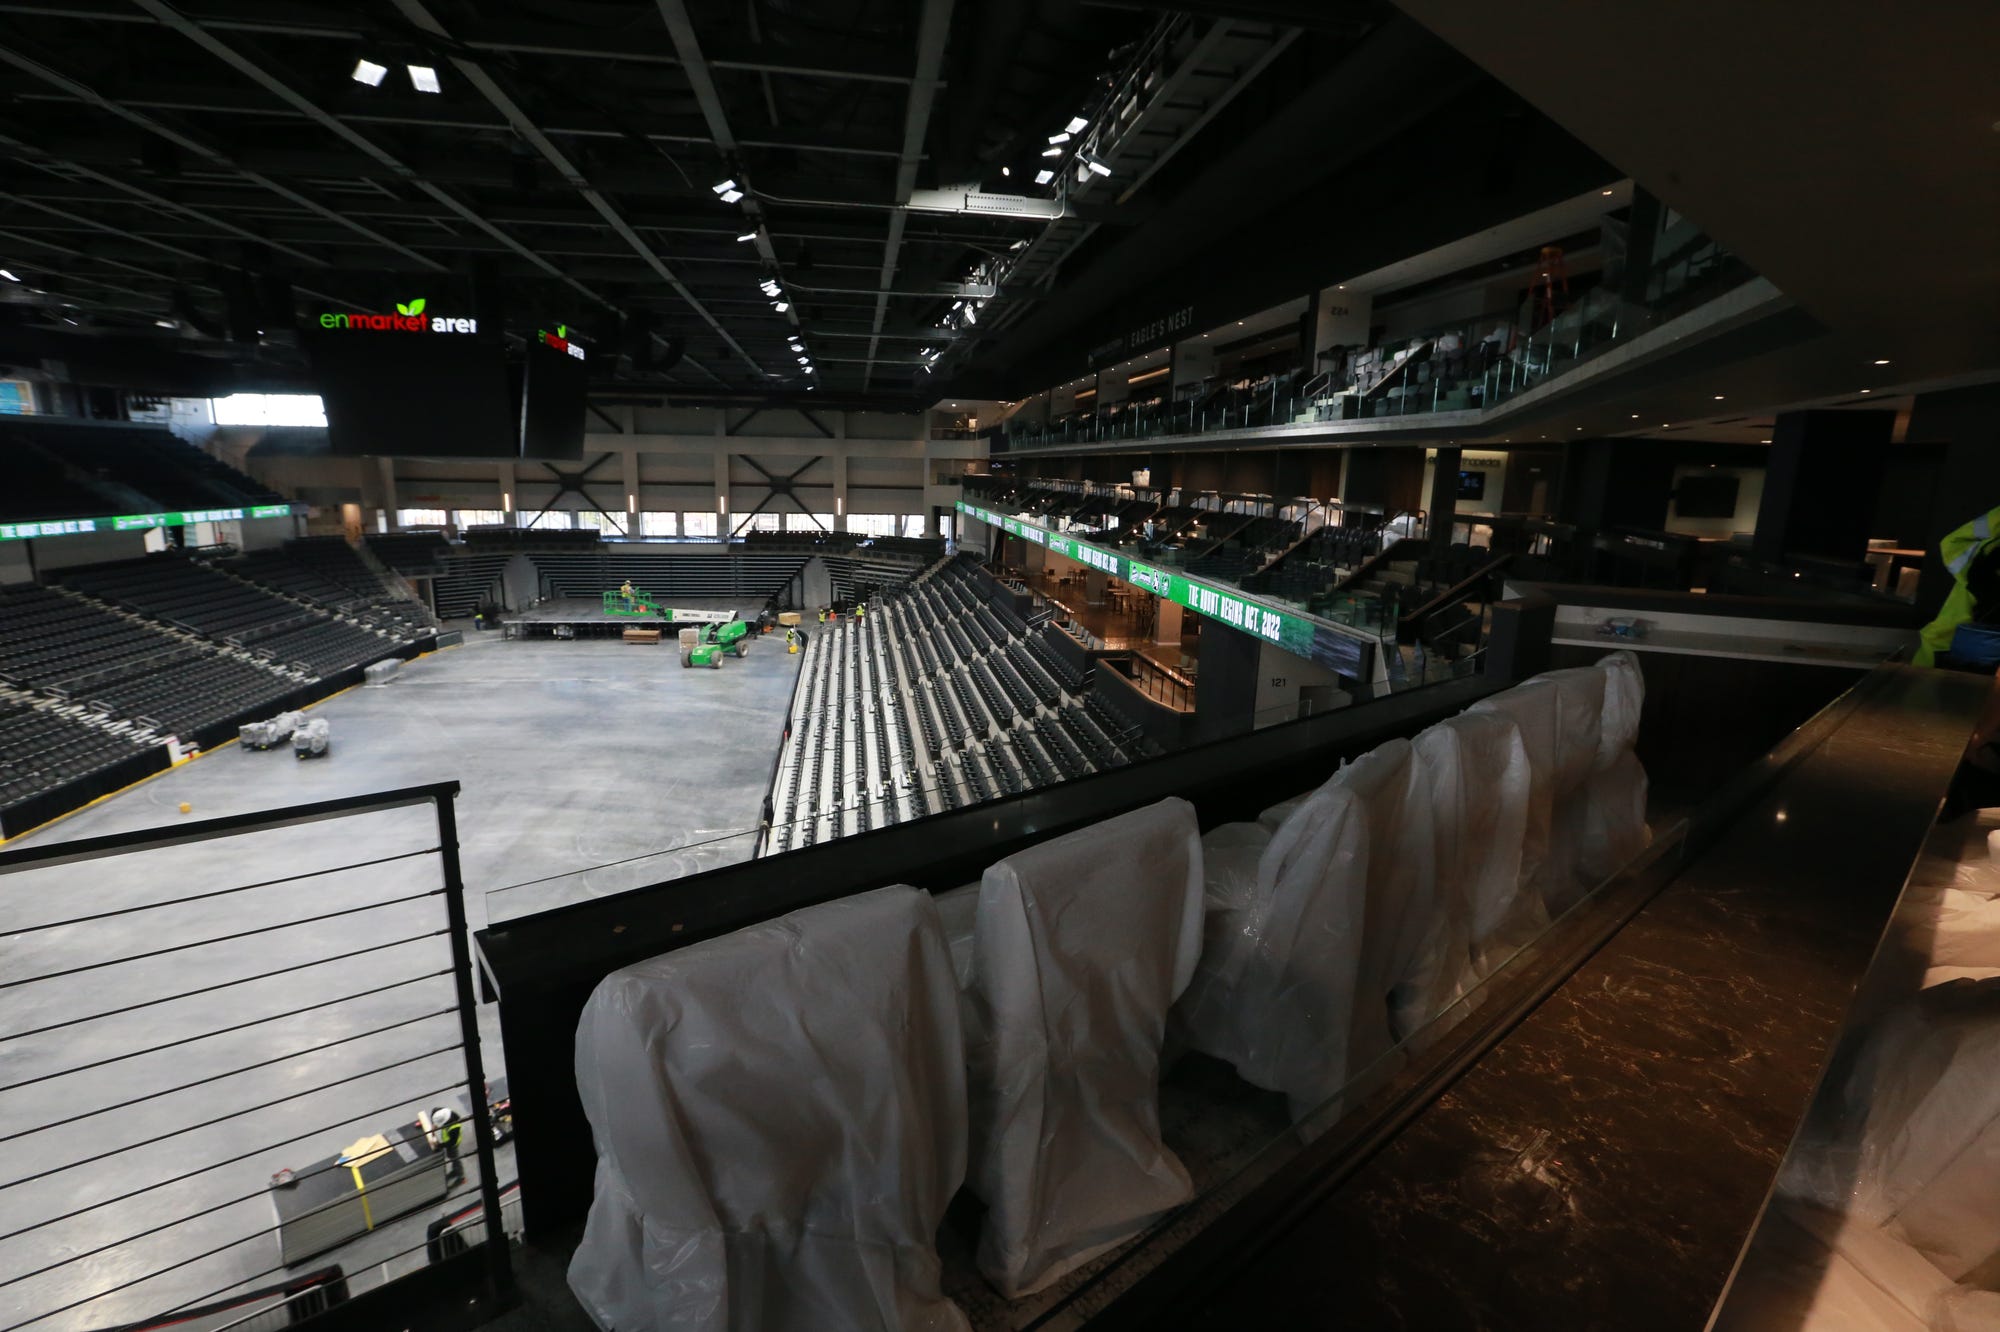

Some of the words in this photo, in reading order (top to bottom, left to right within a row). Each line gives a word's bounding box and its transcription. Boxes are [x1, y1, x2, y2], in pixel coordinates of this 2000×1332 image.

[320, 312, 427, 332] enmarket
[1167, 306, 1193, 333] NEST
[1244, 605, 1259, 633] OCT.
[1261, 611, 1281, 641] 2022
[1272, 678, 1286, 688] 121
